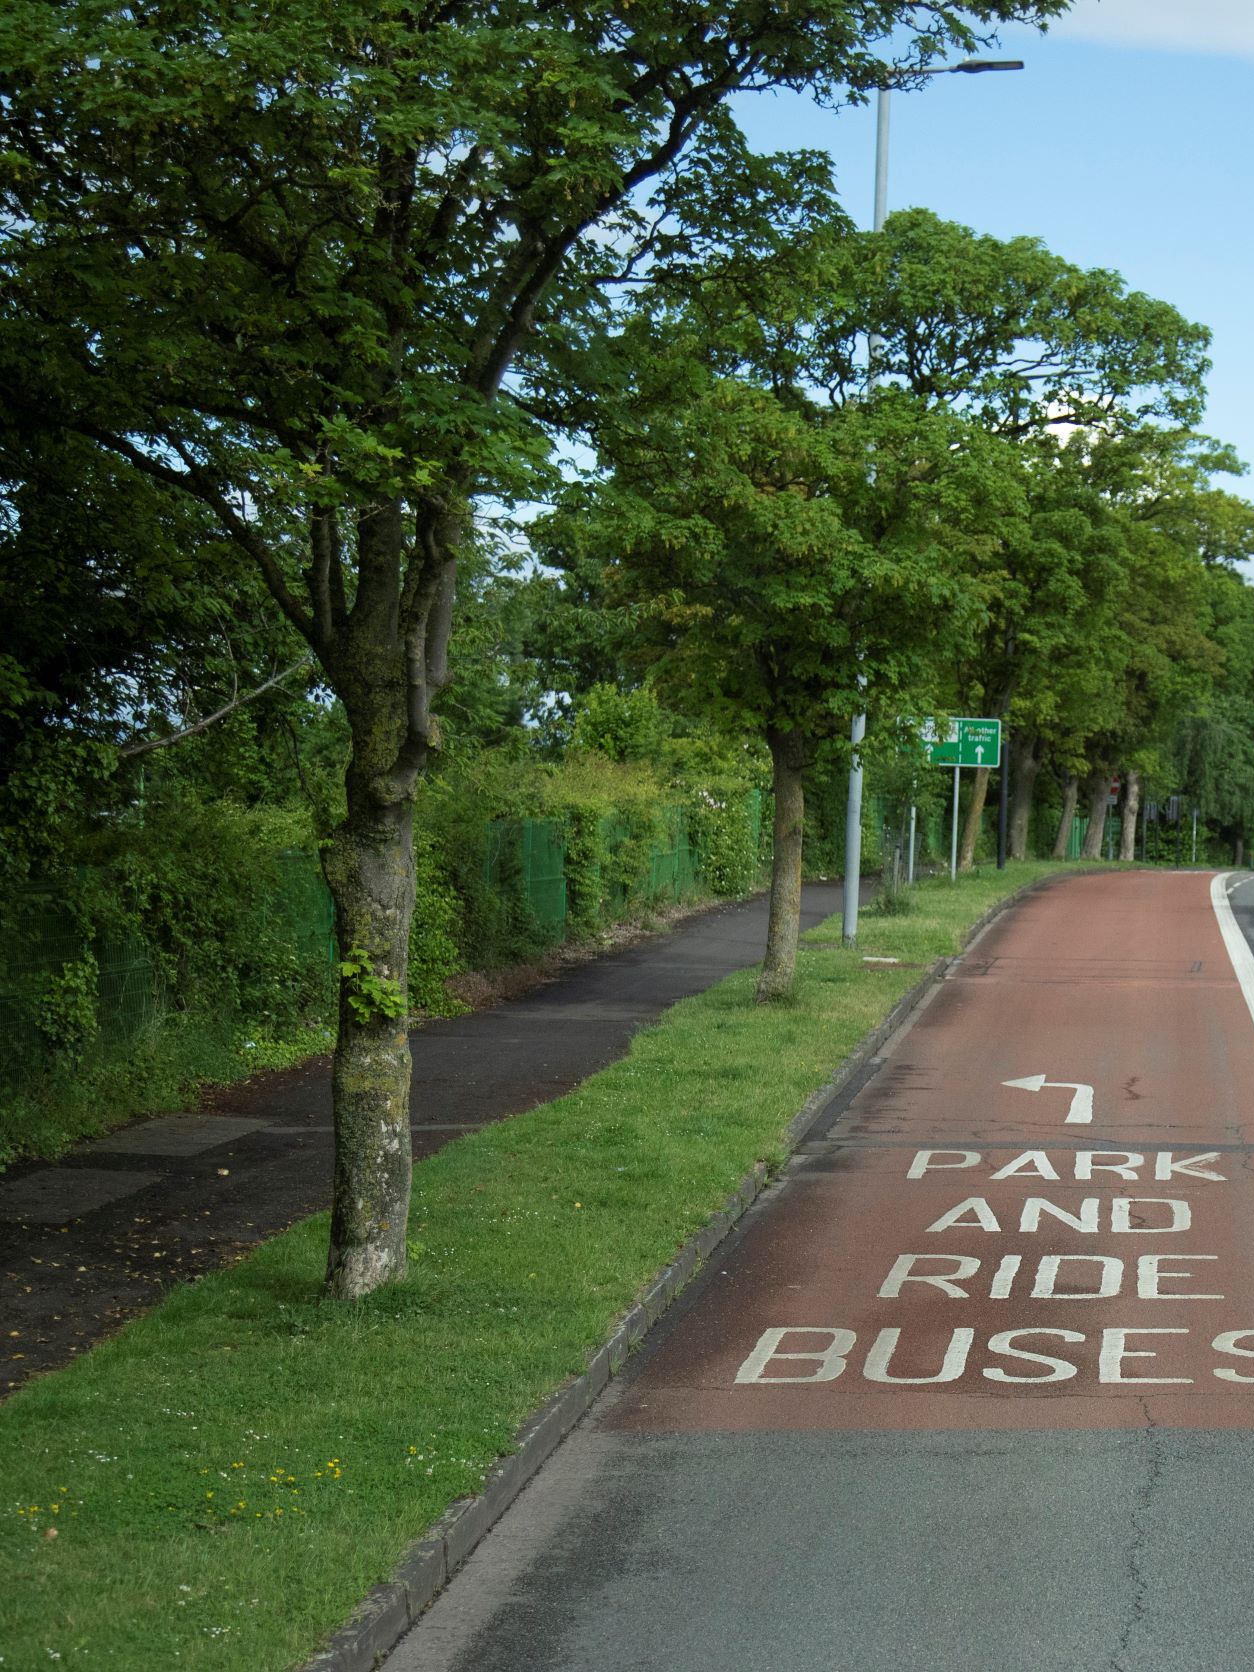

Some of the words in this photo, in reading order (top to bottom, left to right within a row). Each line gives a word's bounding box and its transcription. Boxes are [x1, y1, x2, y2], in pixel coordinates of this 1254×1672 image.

[968, 734, 992, 742] traffic
[906, 1149, 1229, 1182] PARK
[924, 1197, 1192, 1234] AND
[876, 1253, 1225, 1300] RIDE
